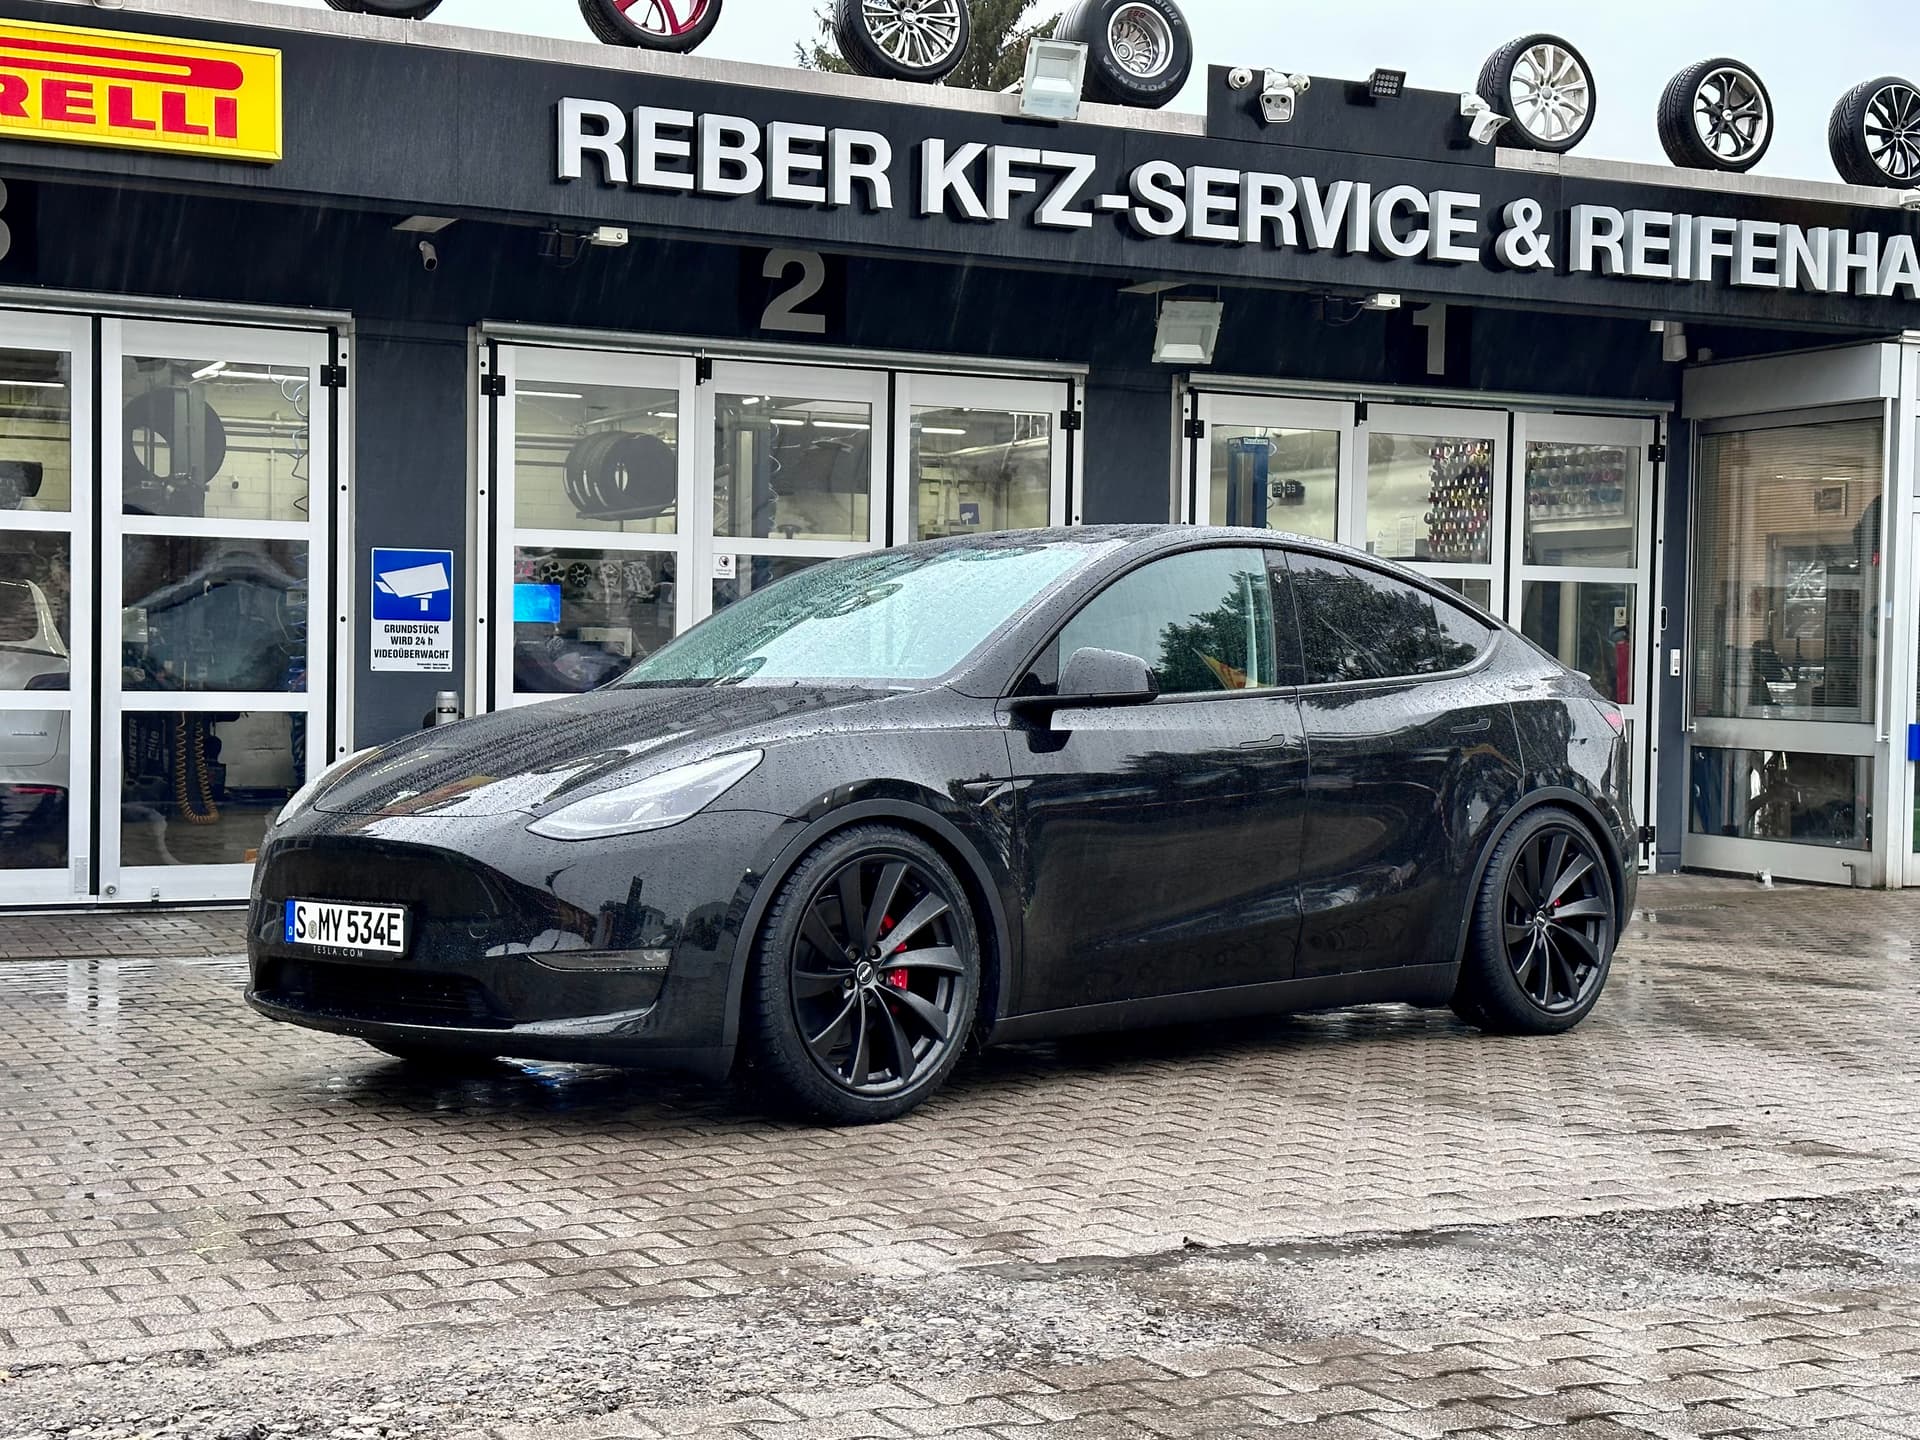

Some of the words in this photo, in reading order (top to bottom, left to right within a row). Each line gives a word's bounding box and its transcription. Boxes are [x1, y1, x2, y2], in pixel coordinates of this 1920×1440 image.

[557, 96, 893, 210] REBER
[920, 137, 1481, 262] KFZ-SERVICE
[1495, 197, 1555, 269] &
[1569, 204, 1920, 299] REIFENHA
[760, 248, 826, 334] 2
[1412, 303, 1446, 375] 1
[384, 623, 440, 635] GRUNDSTÜCK
[391, 636, 413, 646] WIRD
[415, 636, 426, 646] 24
[428, 636, 433, 646] h
[374, 648, 450, 660] VIDEOÜBERWACHT
[288, 925, 294, 936] D
[296, 905, 307, 939] S
[318, 907, 343, 942] MY
[347, 910, 401, 947] 534E
[313, 945, 364, 958] TESLA.COM
